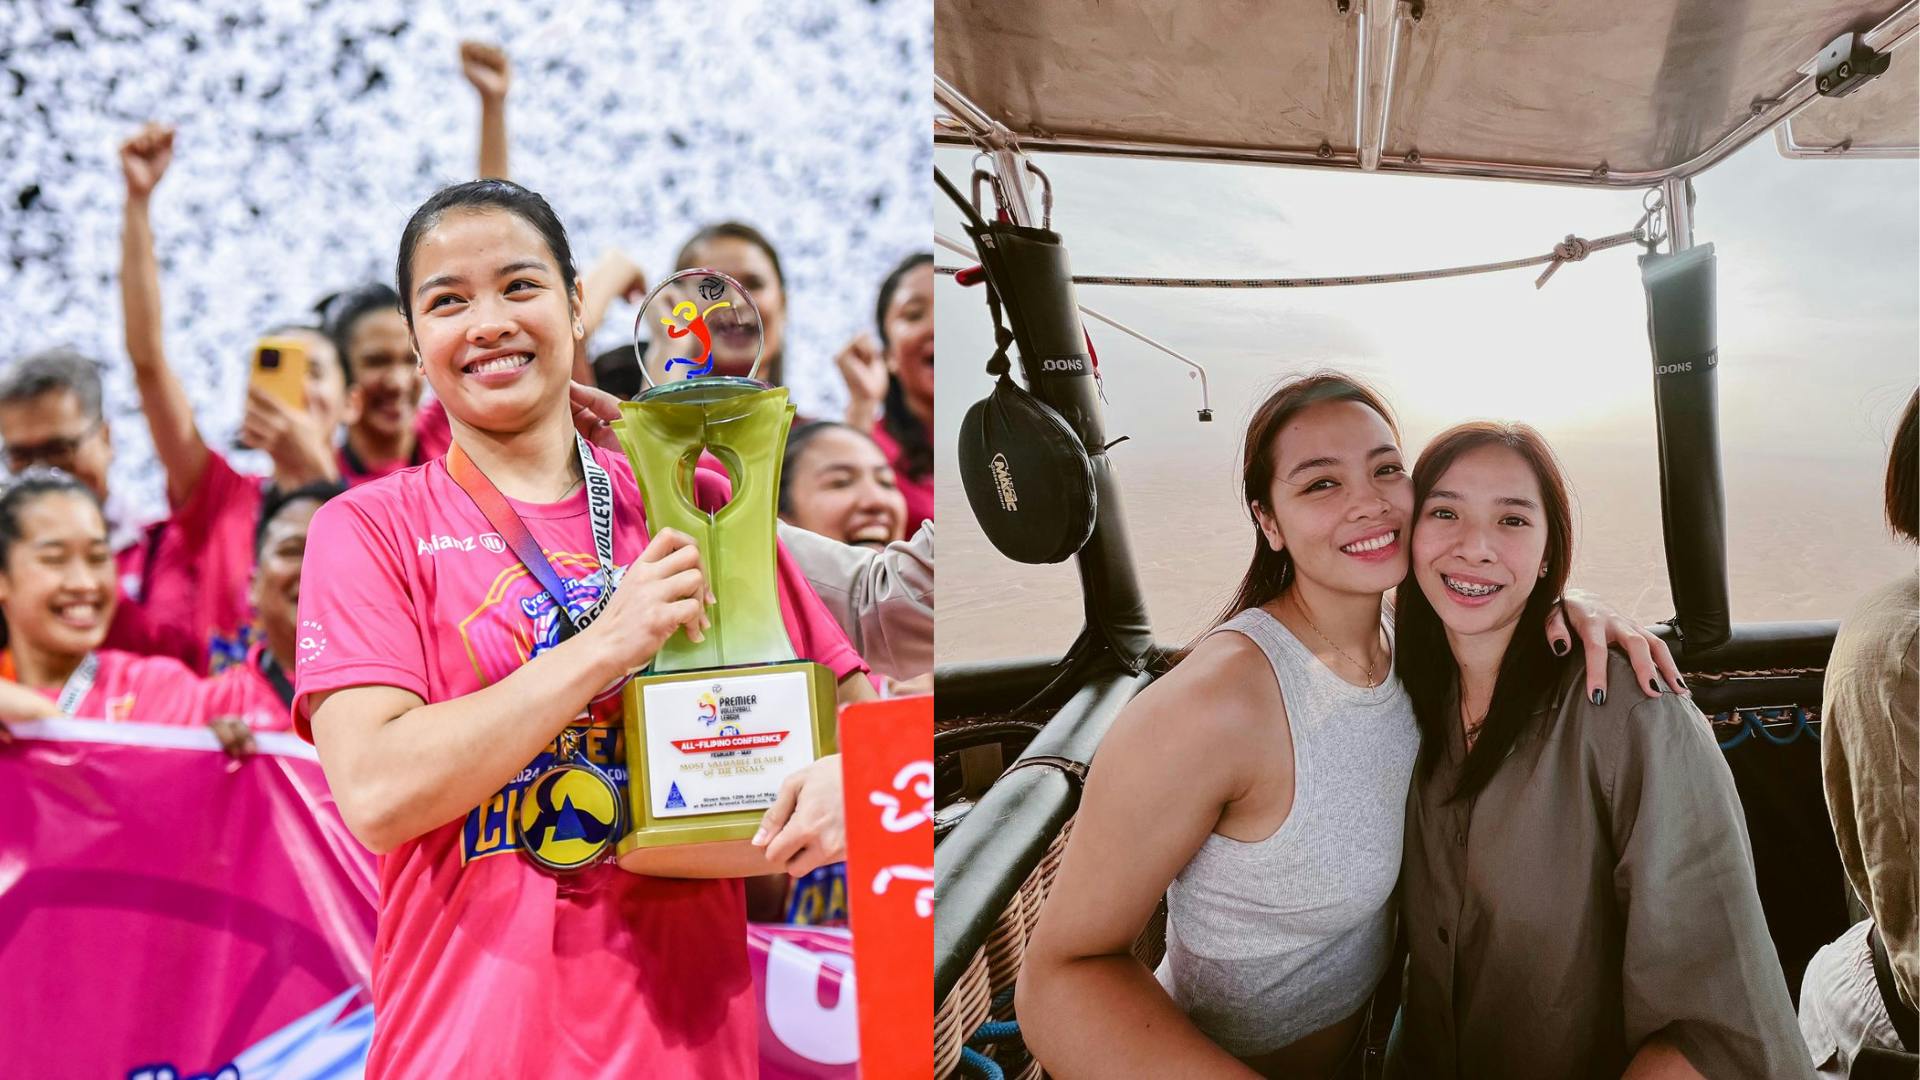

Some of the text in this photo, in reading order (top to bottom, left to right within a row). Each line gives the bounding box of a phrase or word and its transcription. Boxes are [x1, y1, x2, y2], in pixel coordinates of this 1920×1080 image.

[1042, 359, 1083, 371] OONS
[588, 465, 611, 561] VOLLEYBALL
[719, 694, 757, 706] PREMIER
[681, 735, 781, 750] ALL-FILIPINO CONFERENCE
